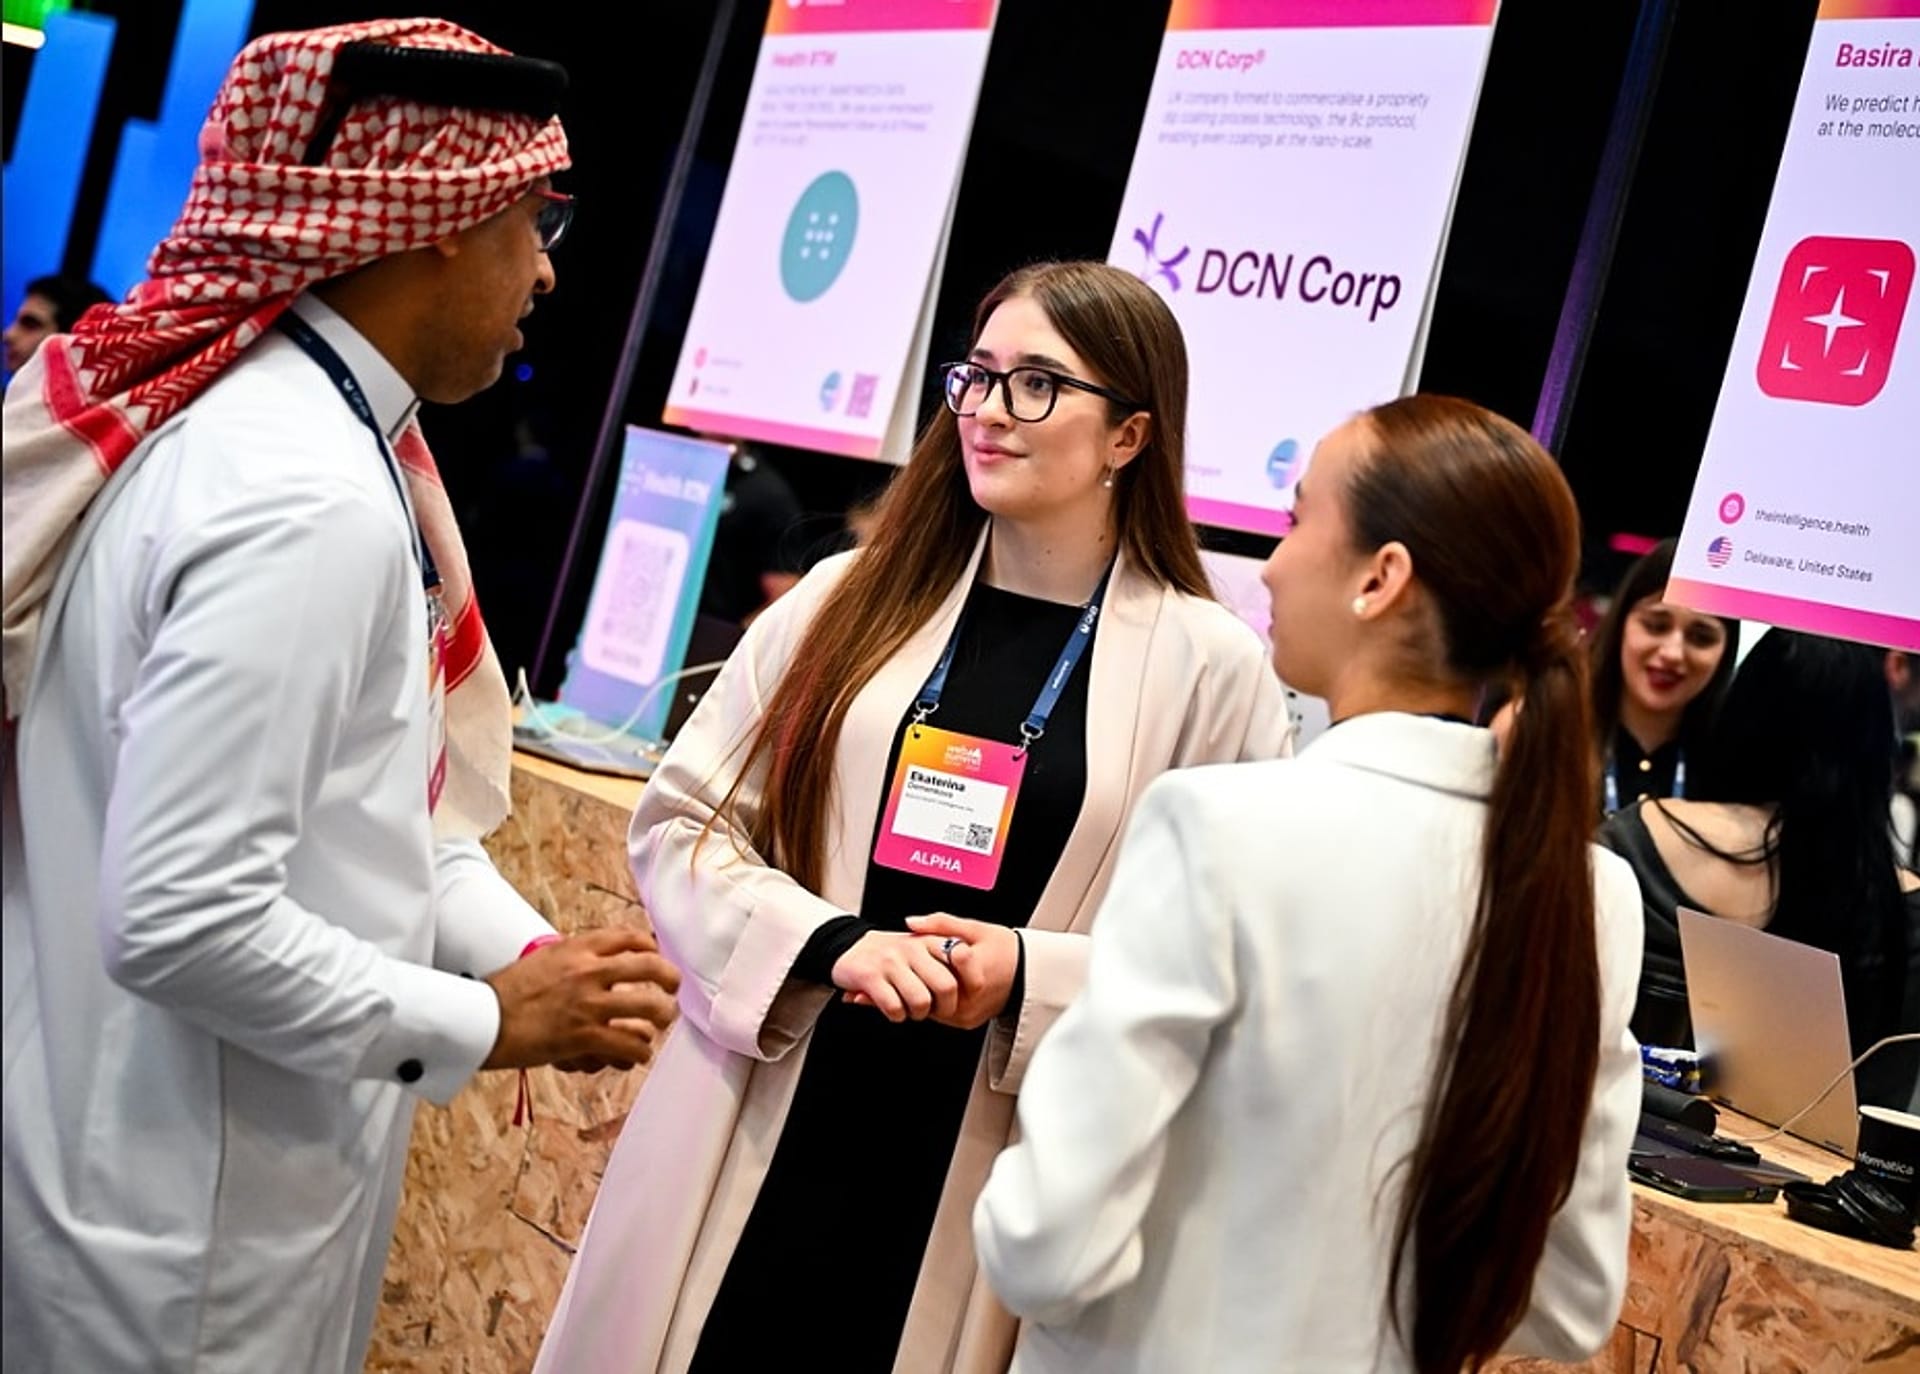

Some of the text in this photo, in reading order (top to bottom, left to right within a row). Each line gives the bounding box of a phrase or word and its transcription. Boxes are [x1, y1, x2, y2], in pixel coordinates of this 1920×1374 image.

[1177, 49, 1213, 69] DCN
[1836, 42, 1913, 67] Basira
[1375, 92, 1430, 112] propriety
[1825, 93, 1849, 113] We
[1851, 94, 1909, 116] predict
[1327, 112, 1347, 127] the
[1817, 121, 1834, 136] at
[1837, 120, 1864, 137] the
[1288, 133, 1308, 147] the
[1196, 249, 1402, 323] DCN Corp
[1743, 549, 1873, 582] Delaware, United States
[910, 771, 967, 793] Ekaterina
[910, 850, 963, 874] ALPHA
